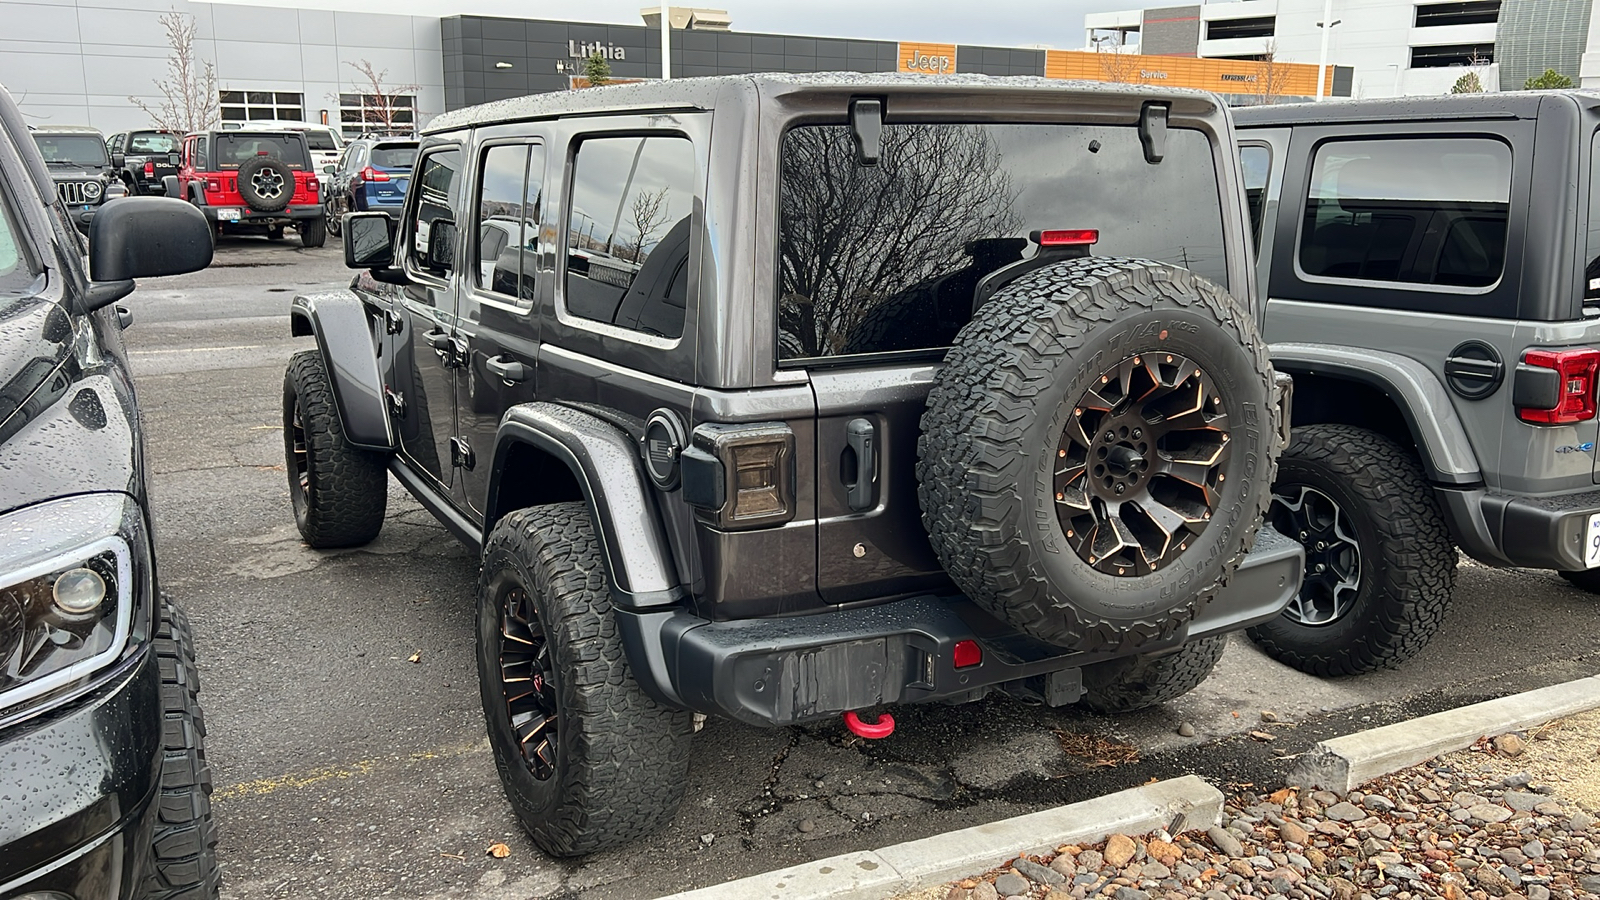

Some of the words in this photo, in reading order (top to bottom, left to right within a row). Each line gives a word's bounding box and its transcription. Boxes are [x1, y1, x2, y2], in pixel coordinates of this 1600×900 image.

[569, 40, 625, 60] Lithia
[907, 50, 949, 74] Jeep
[1140, 69, 1168, 79] Service
